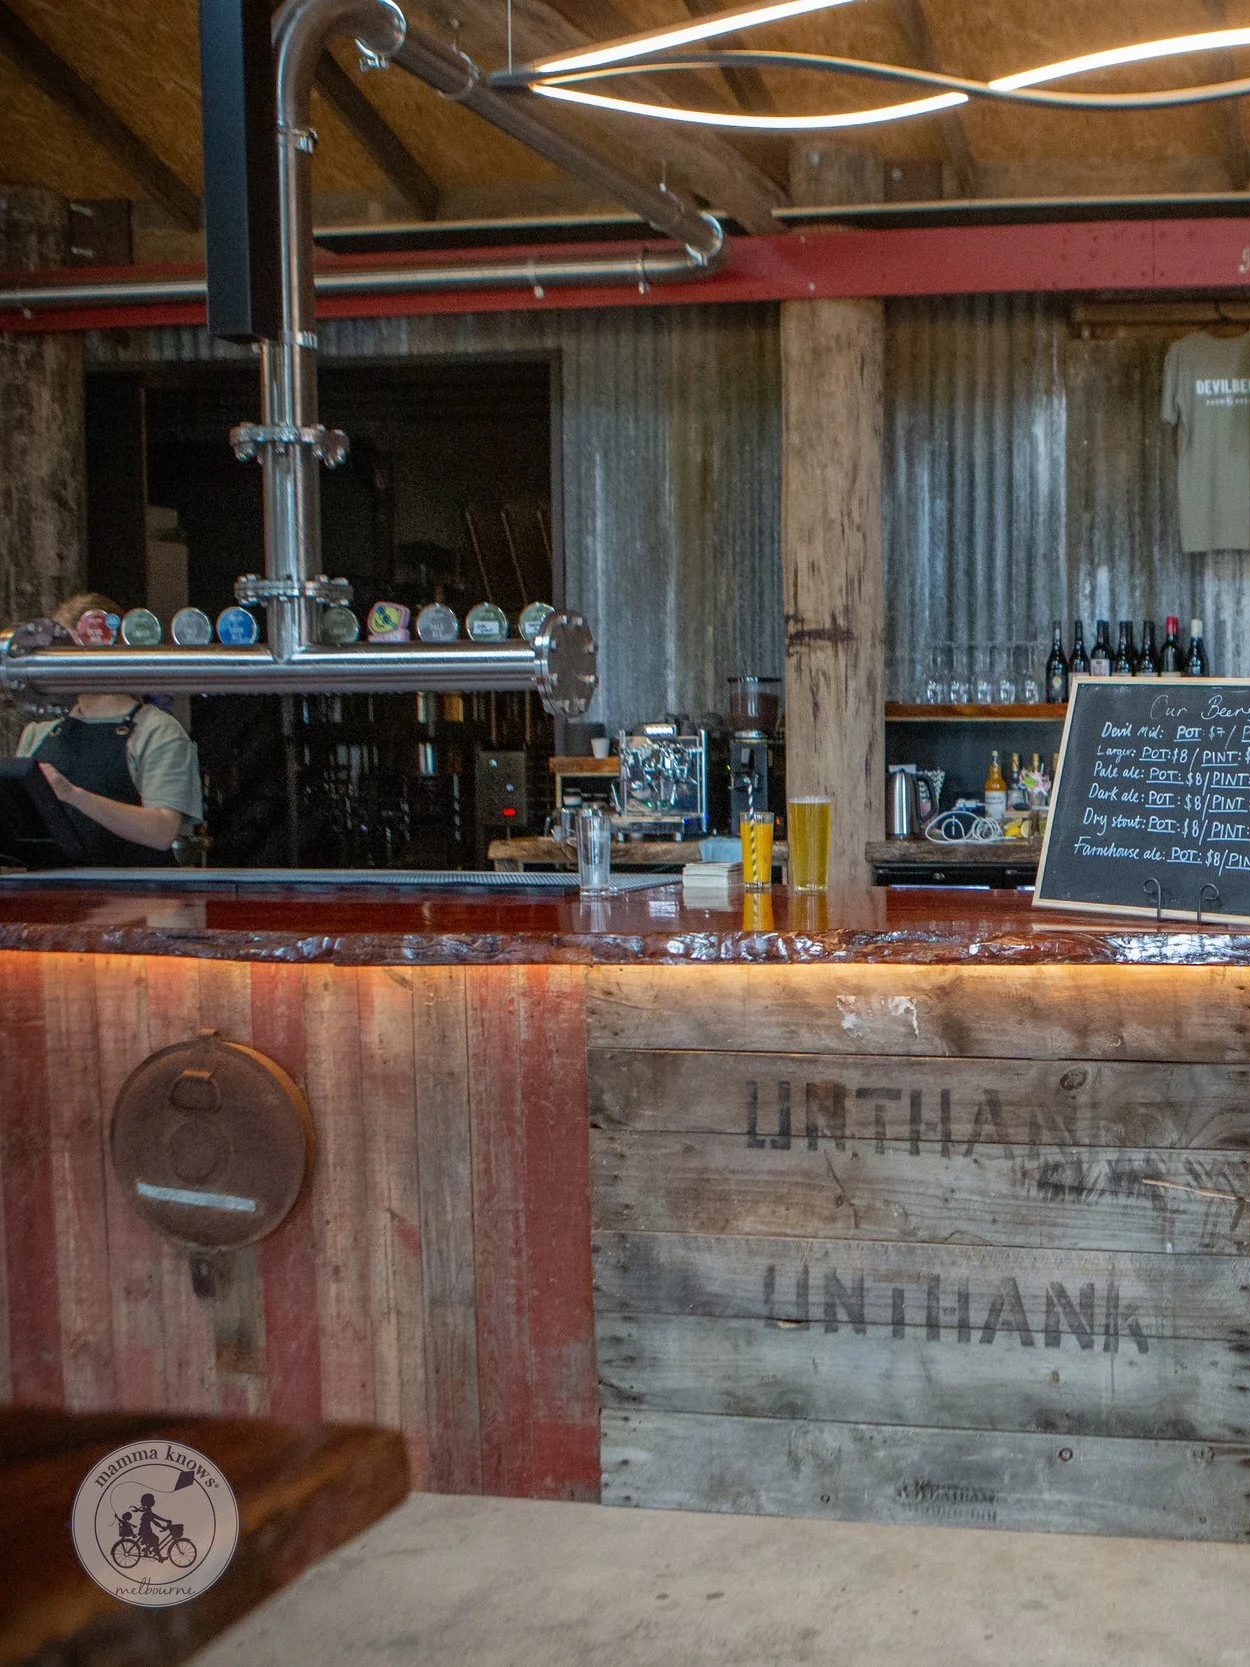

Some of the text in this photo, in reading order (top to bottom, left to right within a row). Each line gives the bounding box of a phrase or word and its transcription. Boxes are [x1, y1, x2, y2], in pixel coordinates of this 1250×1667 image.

[1101, 721, 1133, 738] Devil
[1209, 725, 1226, 741] $7
[1093, 761, 1119, 779] Pale
[1088, 782, 1119, 801] Dark
[1082, 807, 1108, 836] Dry
[1074, 836, 1140, 859] Farmhouse
[762, 1263, 1151, 1355] UNTHANK
